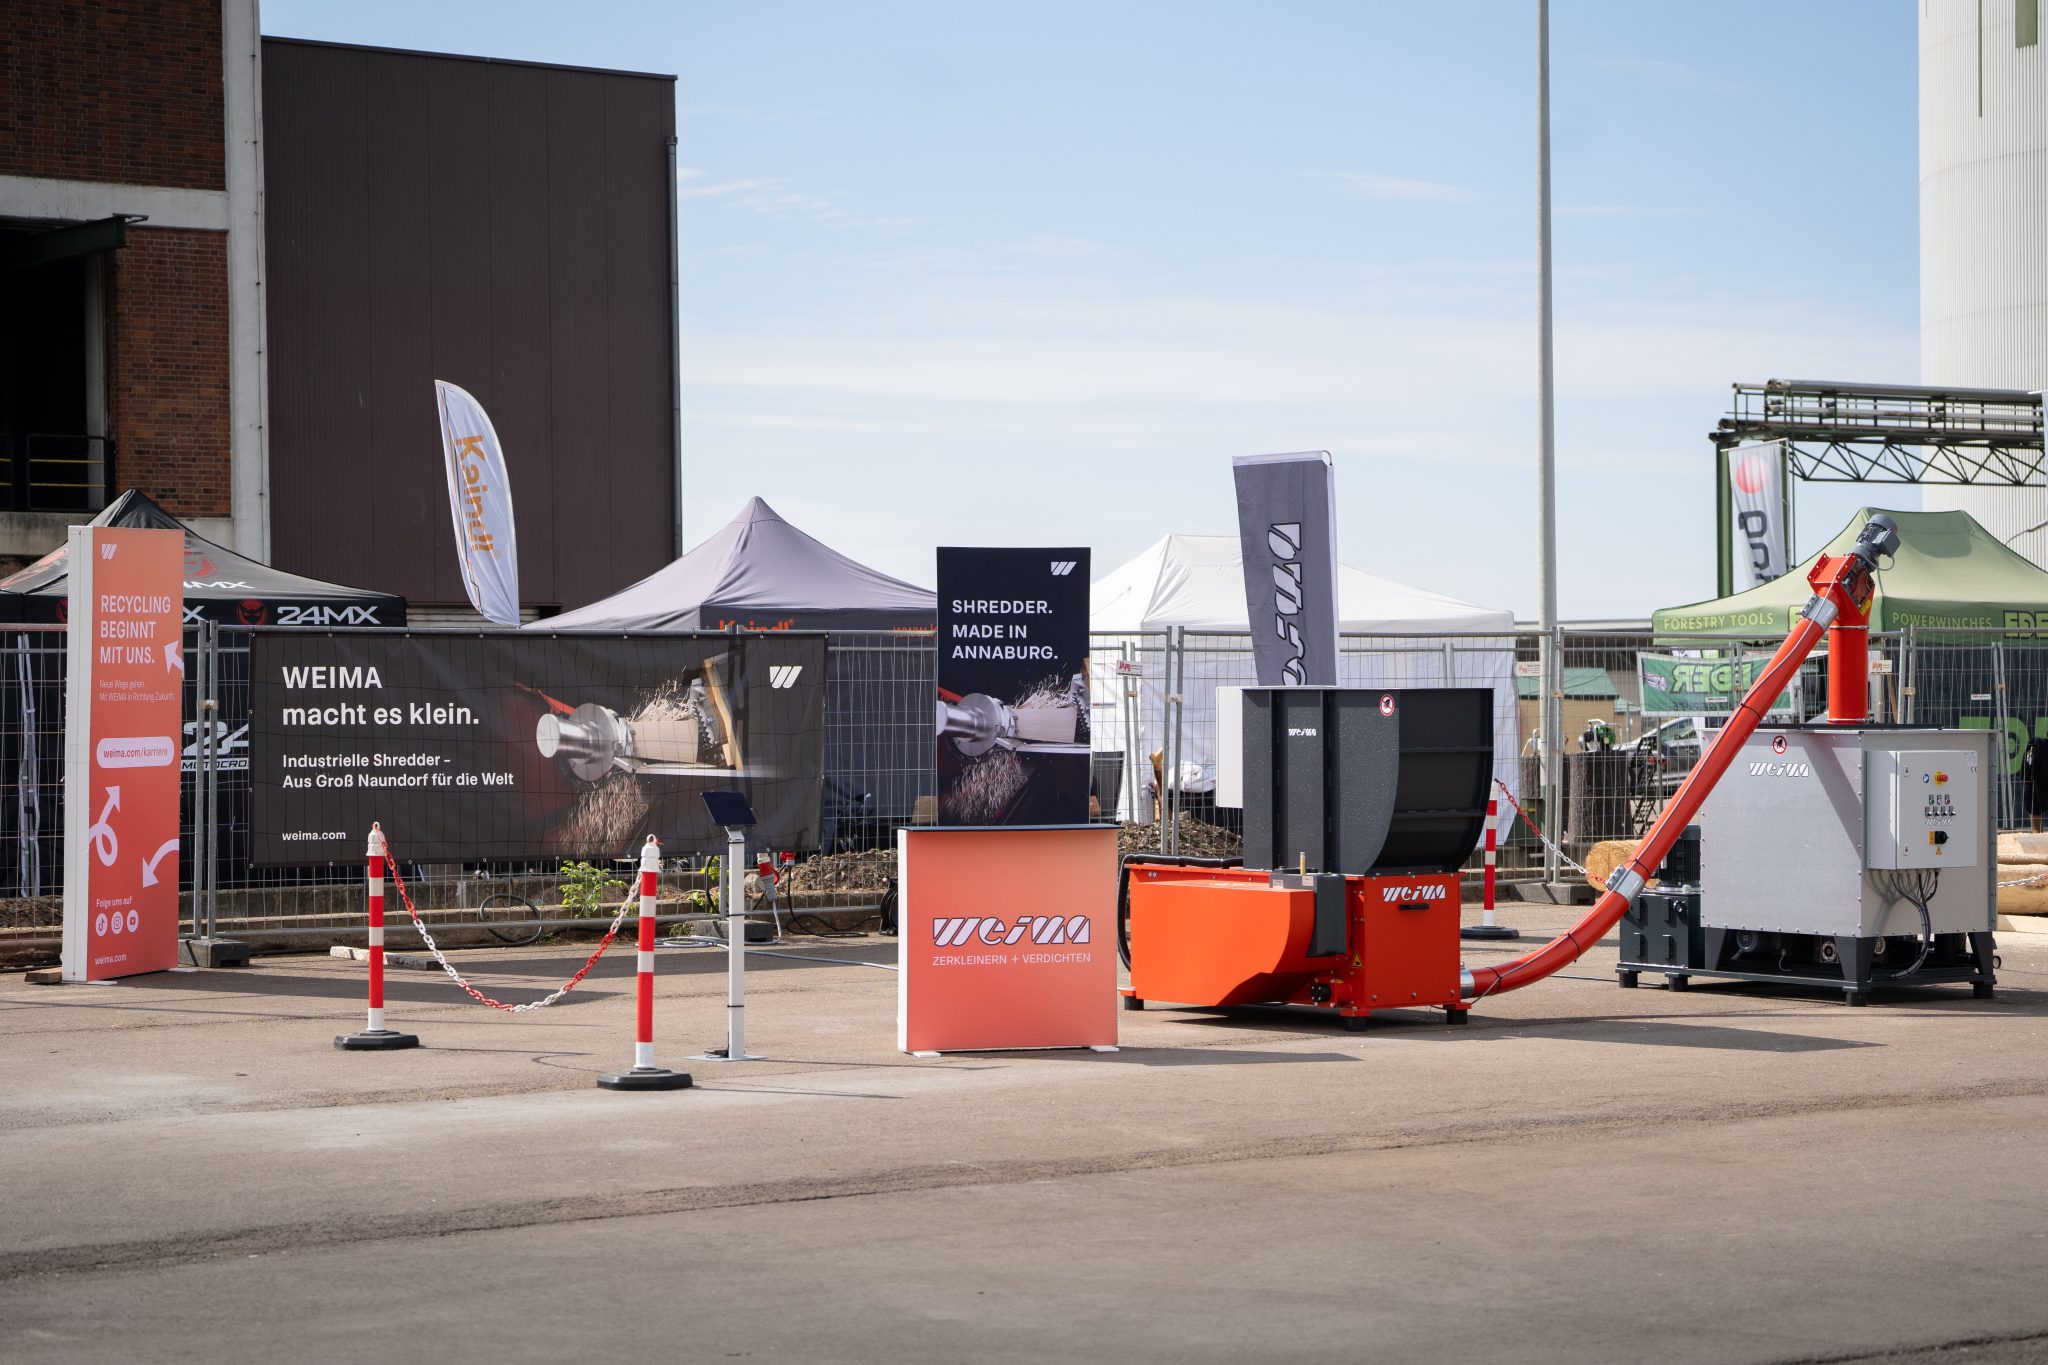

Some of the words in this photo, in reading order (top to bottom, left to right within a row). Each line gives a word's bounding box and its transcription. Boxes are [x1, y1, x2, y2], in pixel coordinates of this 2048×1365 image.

[455, 434, 494, 552] Kaindl
[184, 581, 255, 589] 4MX
[101, 595, 171, 614] RECYCLING
[952, 599, 1053, 614] SHREDDER.
[277, 606, 381, 625] 24MX
[1663, 613, 1726, 631] FORESTRY
[1730, 612, 1774, 627] TOOLS
[1892, 611, 1992, 629] POWERWINCHES
[101, 621, 156, 639] BEGINNT
[952, 624, 1004, 638] MADE
[1009, 624, 1027, 639] IN
[100, 646, 123, 664] MIT
[126, 646, 155, 664] UNS.
[951, 645, 1058, 660] ANNABURG.
[282, 666, 383, 689] WEIMA
[109, 692, 127, 701] WEIMA
[282, 703, 367, 726] macht
[373, 707, 402, 725] es
[410, 702, 479, 725] klein.
[103, 747, 168, 759] weima.com/karriere
[282, 753, 370, 768] Industrielle
[373, 752, 441, 767] Shredder
[282, 774, 312, 789] Aus
[315, 773, 354, 788] Groß
[358, 772, 428, 788] Naundorf
[431, 772, 452, 787] für
[455, 772, 478, 786] die
[481, 771, 514, 786] Welt
[282, 830, 347, 842] weima.com
[96, 898, 111, 909] Folge
[112, 899, 122, 907] uns
[123, 896, 132, 905] auf
[933, 914, 1091, 947] weima
[94, 954, 127, 966] weima.com
[932, 955, 1007, 966] ZERKLEINERN
[1022, 953, 1091, 964] VERDICHTEN
